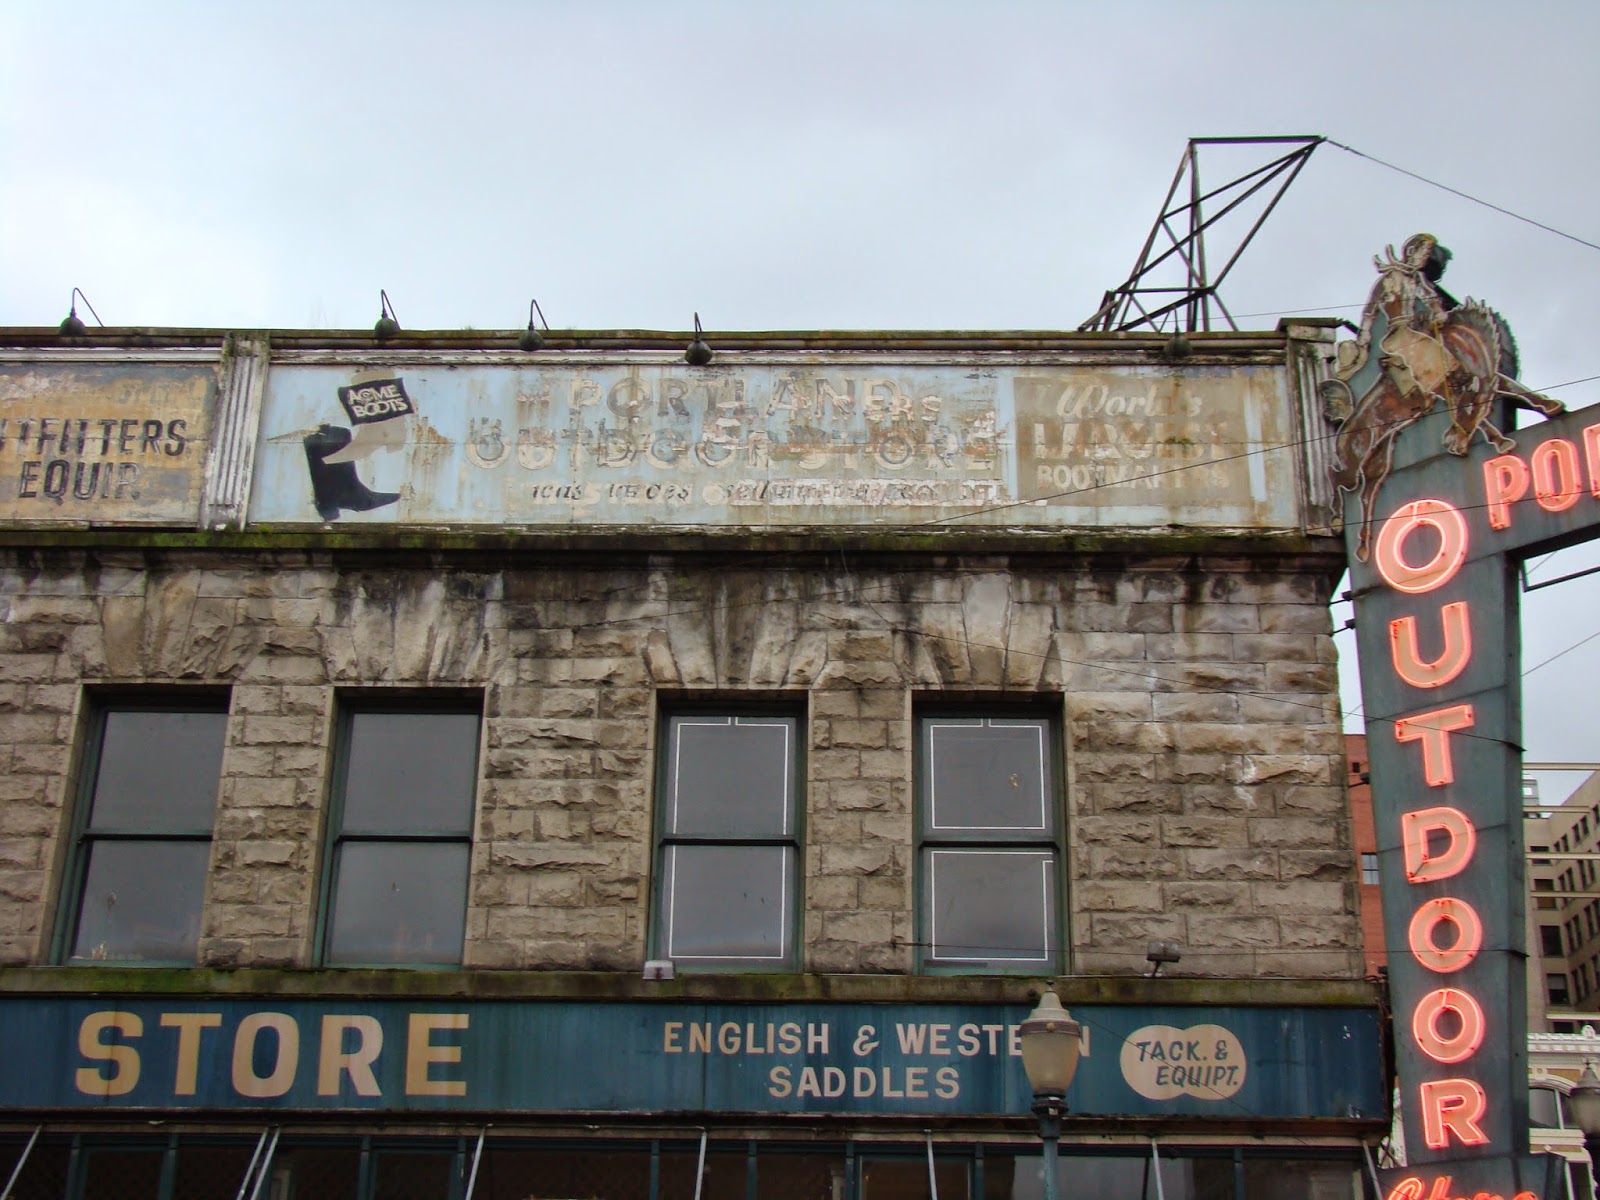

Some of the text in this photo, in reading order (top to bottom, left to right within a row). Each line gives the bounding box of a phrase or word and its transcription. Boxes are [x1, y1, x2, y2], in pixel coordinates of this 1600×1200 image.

[348, 384, 402, 405] ACME
[352, 397, 409, 418] BOOTS
[1375, 498, 1491, 1150] OUTDOOR
[663, 1021, 1091, 1057] ENGLISH & WESTEN
[1214, 1039, 1229, 1061] &
[75, 1010, 470, 1098] STORE
[767, 1066, 961, 1100] SADDLES
[1156, 1065, 1240, 1089] EQUIPT.
